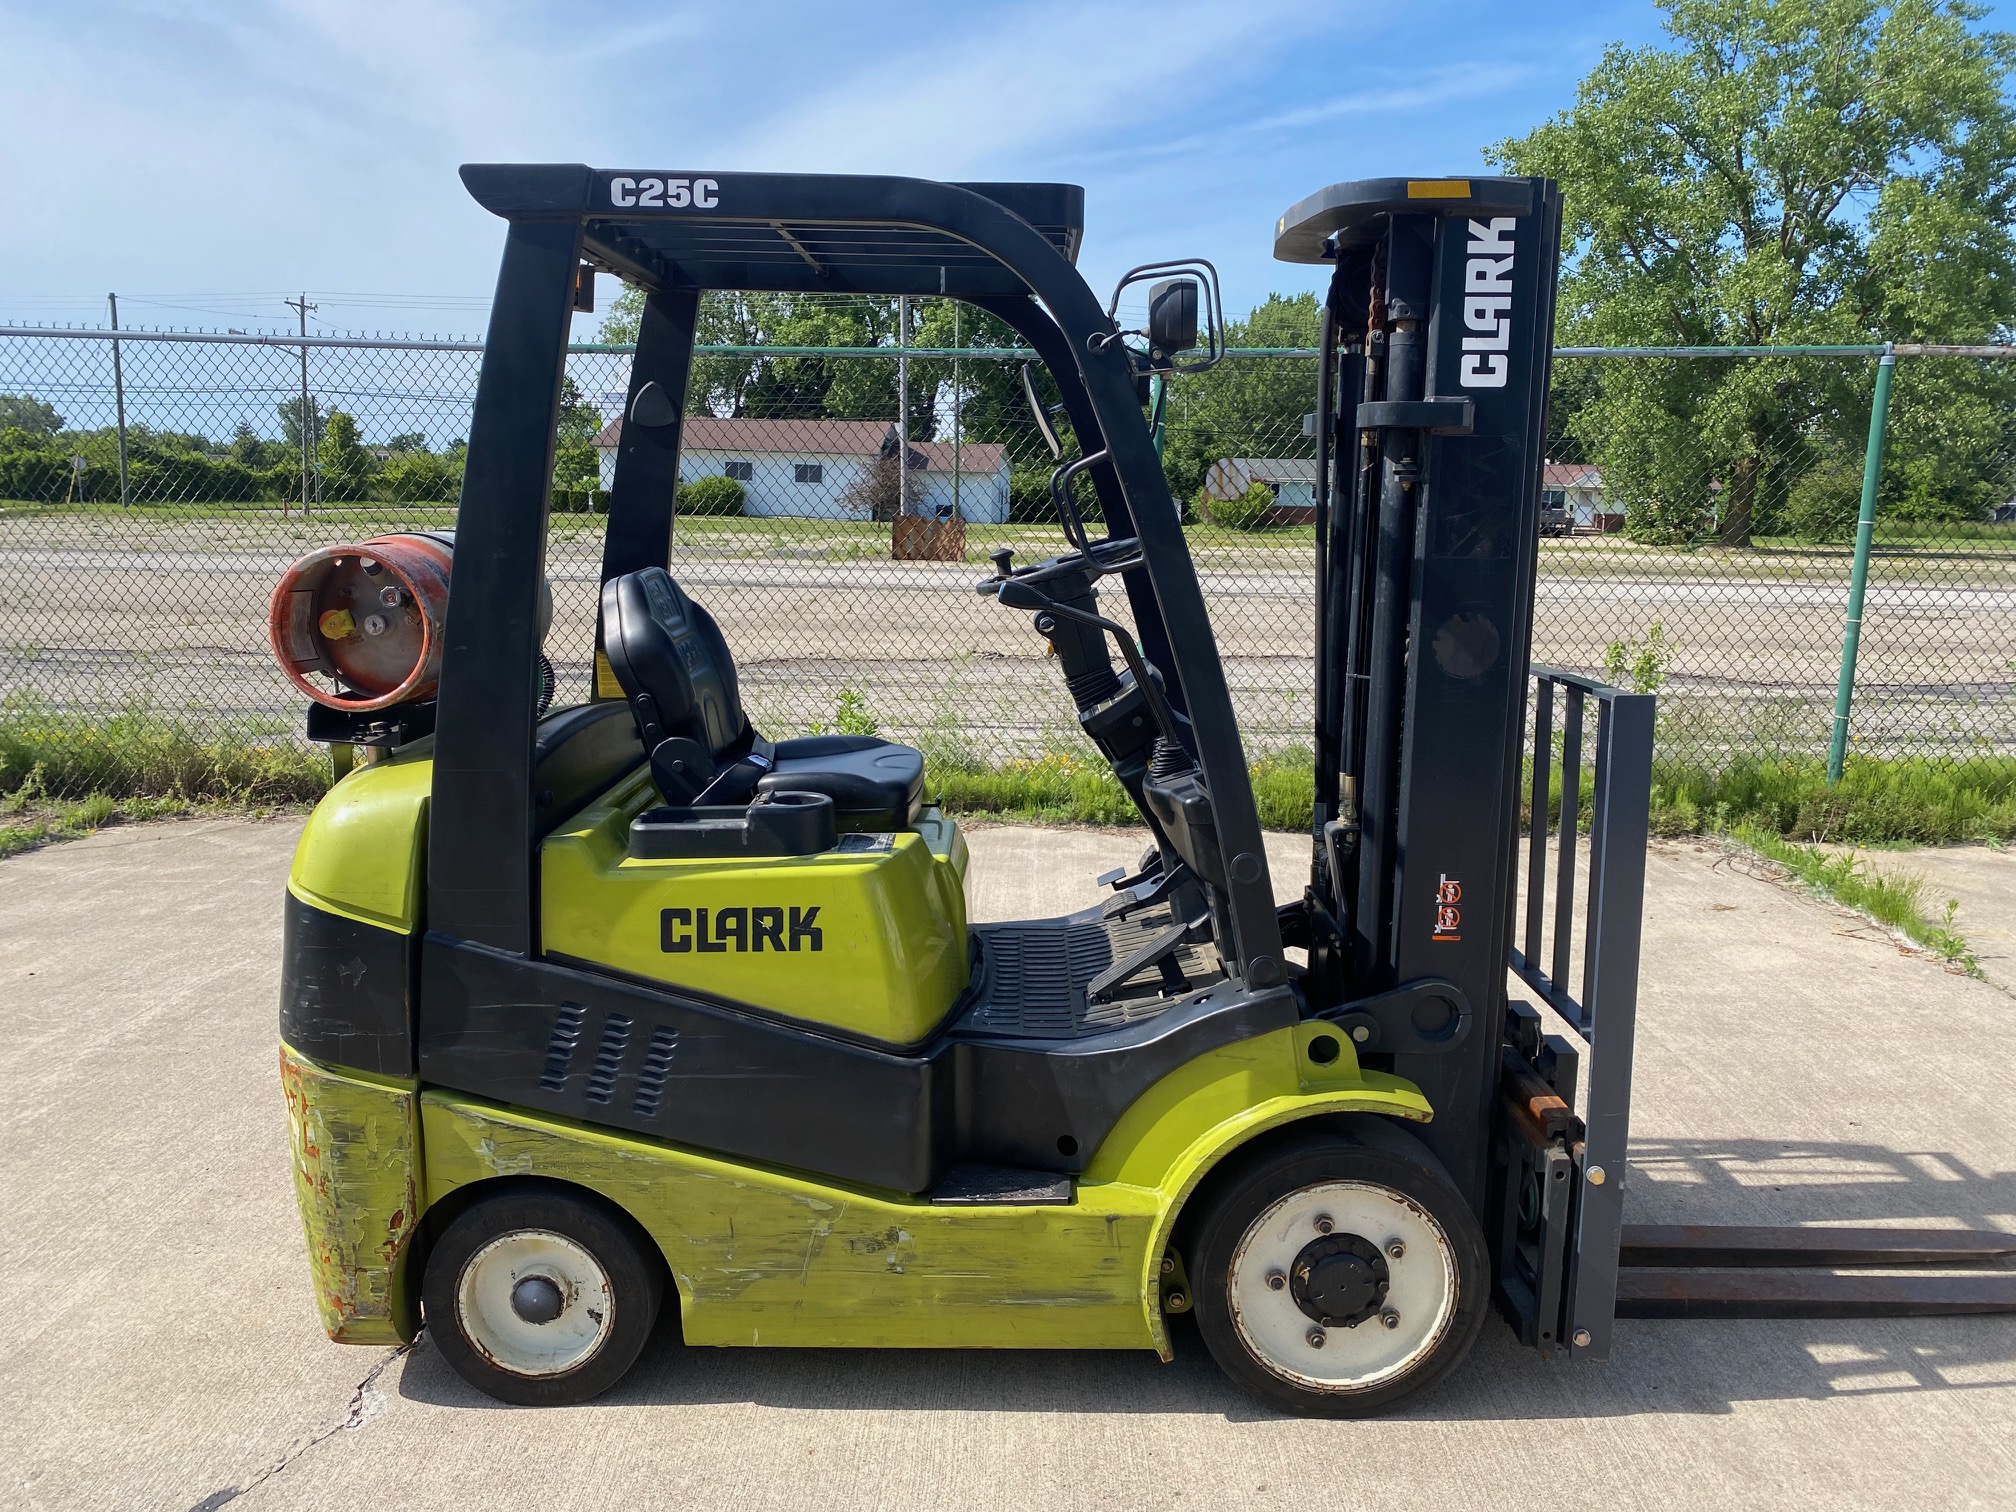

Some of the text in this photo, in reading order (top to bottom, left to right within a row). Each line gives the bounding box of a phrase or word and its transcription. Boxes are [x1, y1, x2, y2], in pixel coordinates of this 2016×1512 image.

[610, 177, 719, 208] C25C
[1460, 217, 1516, 387] CLARK
[660, 906, 823, 952] CLARK
